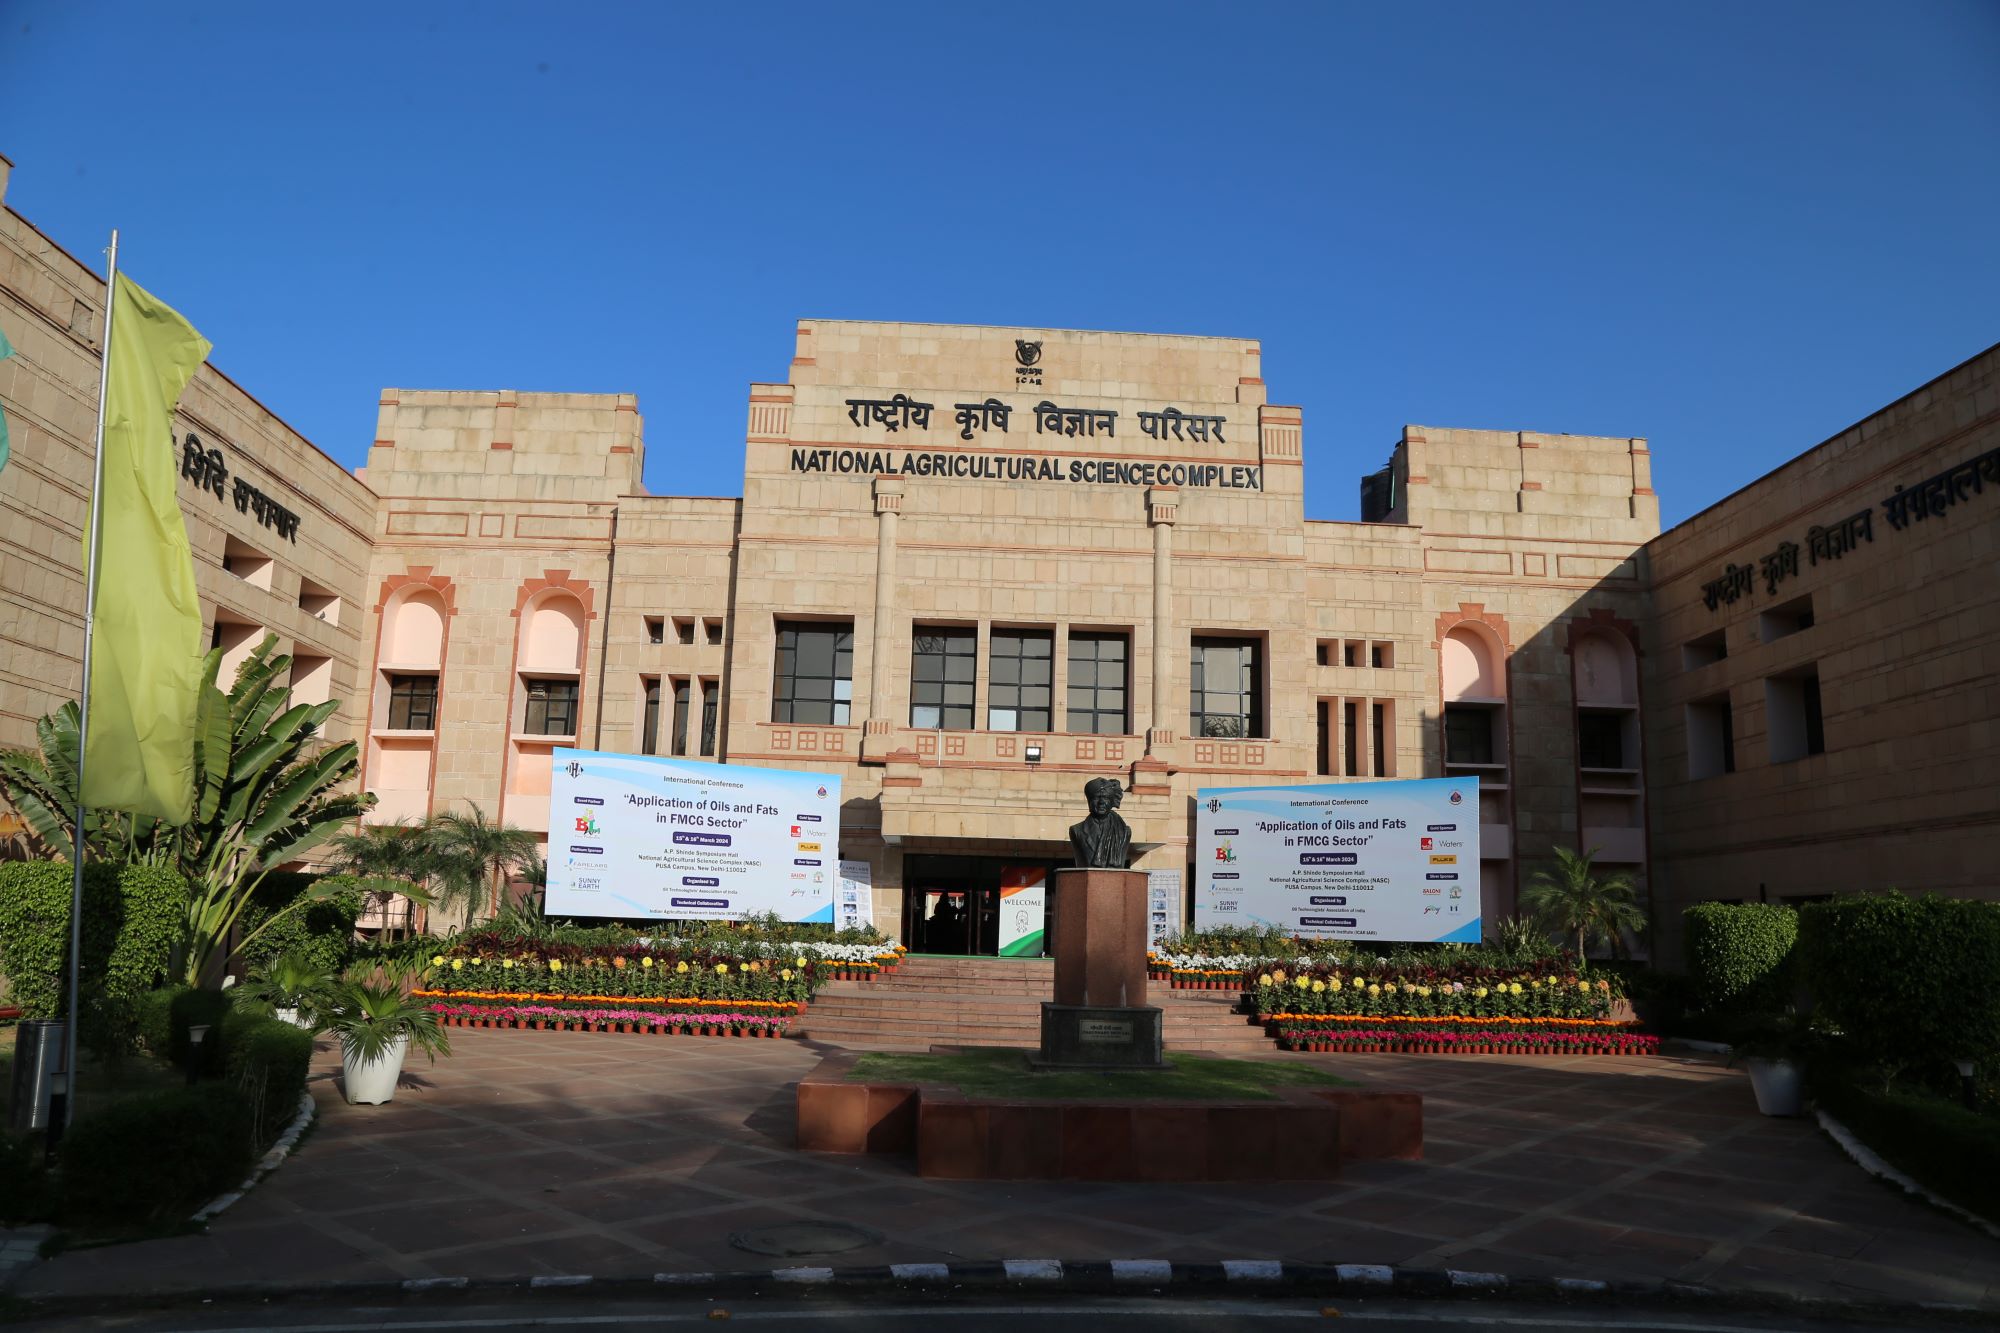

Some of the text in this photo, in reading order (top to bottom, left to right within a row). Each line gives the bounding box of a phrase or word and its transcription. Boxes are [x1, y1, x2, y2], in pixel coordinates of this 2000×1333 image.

[845, 393, 1227, 443] राष्ट्रीय कृषि विज्ञान परिसर
[791, 449, 1259, 489] NATIONAL AGRICULTURAL SCIENCE COMPLEX
[232, 476, 301, 547] सभागार
[1760, 541, 1799, 596] कृषि
[1806, 508, 1873, 567] विज्ञान
[663, 776, 744, 789] International Conference
[696, 800, 707, 810] of
[710, 800, 730, 812] Oils
[733, 803, 753, 814] and
[756, 804, 779, 816] Fats
[656, 812, 666, 823] in
[670, 814, 704, 826] FMCG
[1321, 820, 1332, 830] of
[1335, 820, 1355, 830] Oils
[1358, 819, 1379, 830] and
[1382, 818, 1406, 829] Fats
[1284, 836, 1294, 846] in
[1297, 835, 1329, 846] FMCG
[1439, 840, 1463, 848] Waters
[696, 850, 726, 858] Symposium
